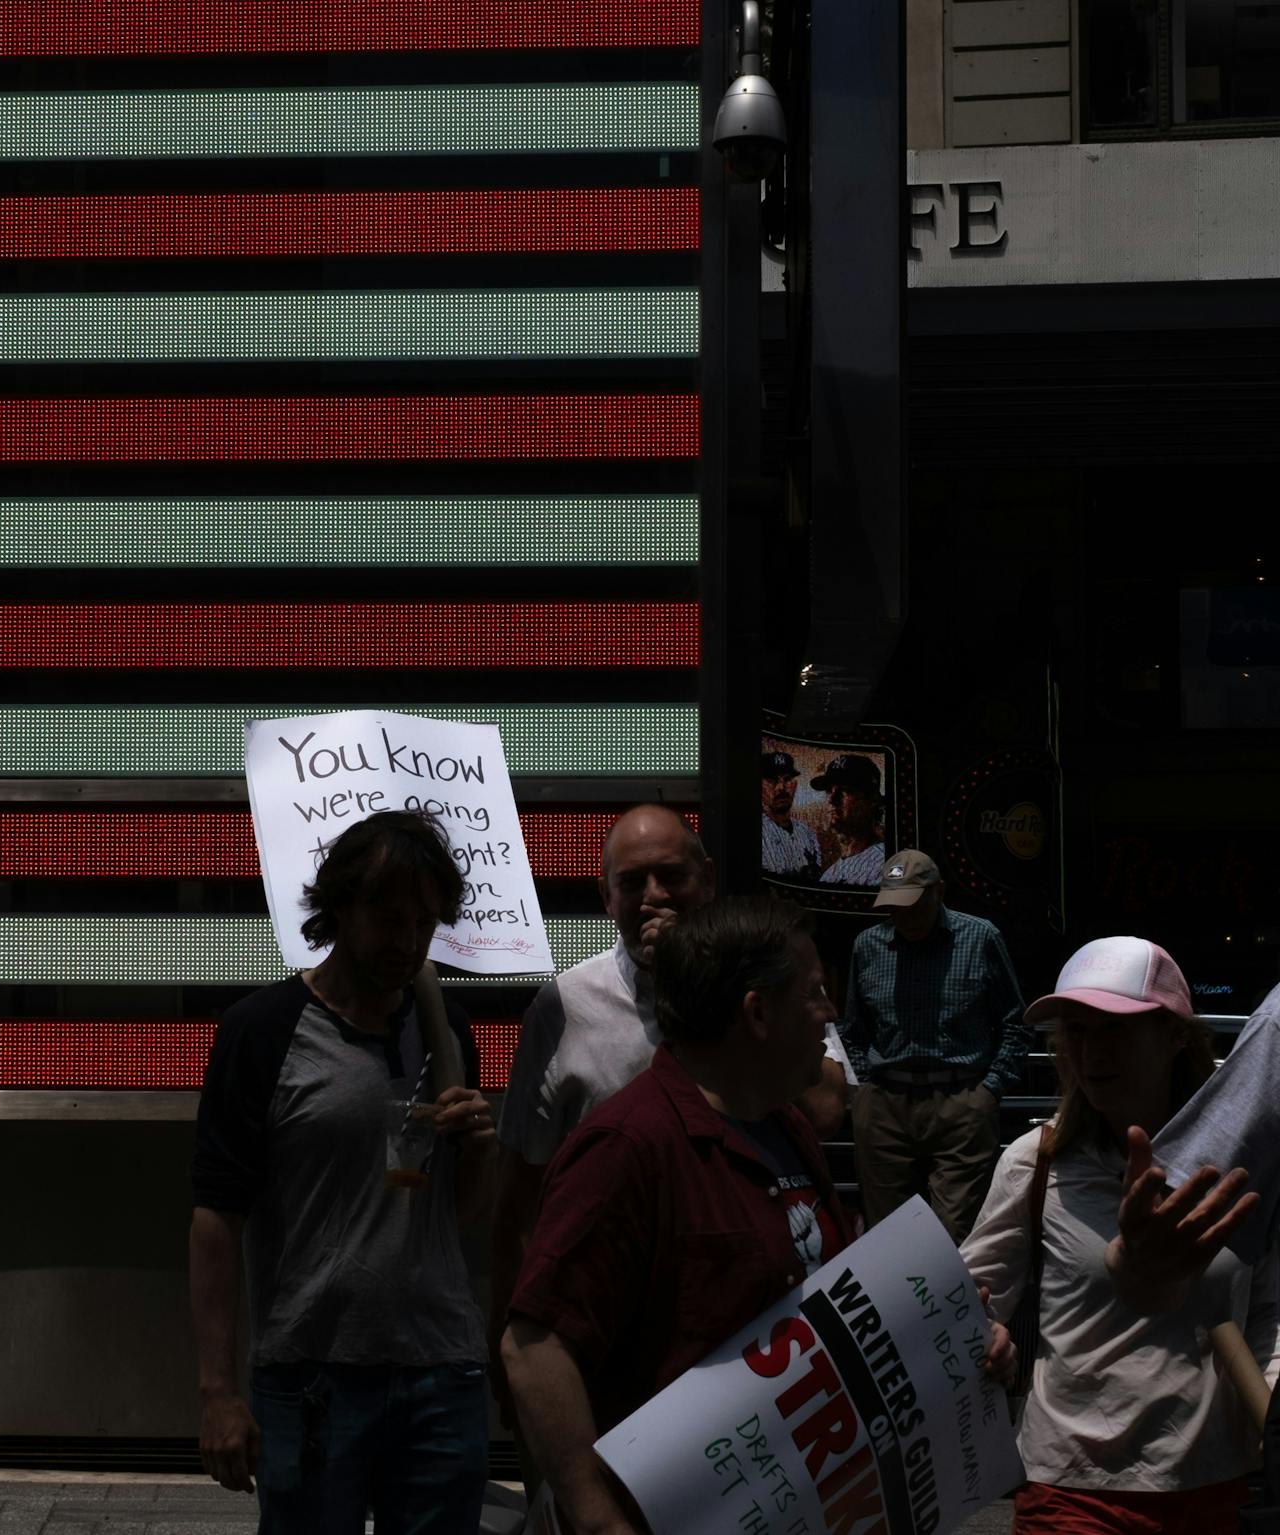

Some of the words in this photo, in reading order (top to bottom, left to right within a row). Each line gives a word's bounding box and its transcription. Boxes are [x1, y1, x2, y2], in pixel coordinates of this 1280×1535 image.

[277, 731, 380, 783] You
[381, 727, 485, 784] know
[293, 789, 391, 823] we're
[404, 795, 490, 831] going
[452, 841, 511, 877] ght?
[461, 881, 503, 906] gn
[945, 1281, 970, 1321] DO
[906, 1275, 942, 1320] ANY
[933, 1330, 967, 1391] IDEA
[742, 1317, 888, 1535] STRIK
[828, 1267, 925, 1437] WRITERS
[904, 1437, 940, 1535] GUILD
[736, 1413, 797, 1513] DRAFTS
[870, 1414, 896, 1457] ON
[704, 1438, 749, 1497] GET
[739, 1499, 769, 1535] TH
